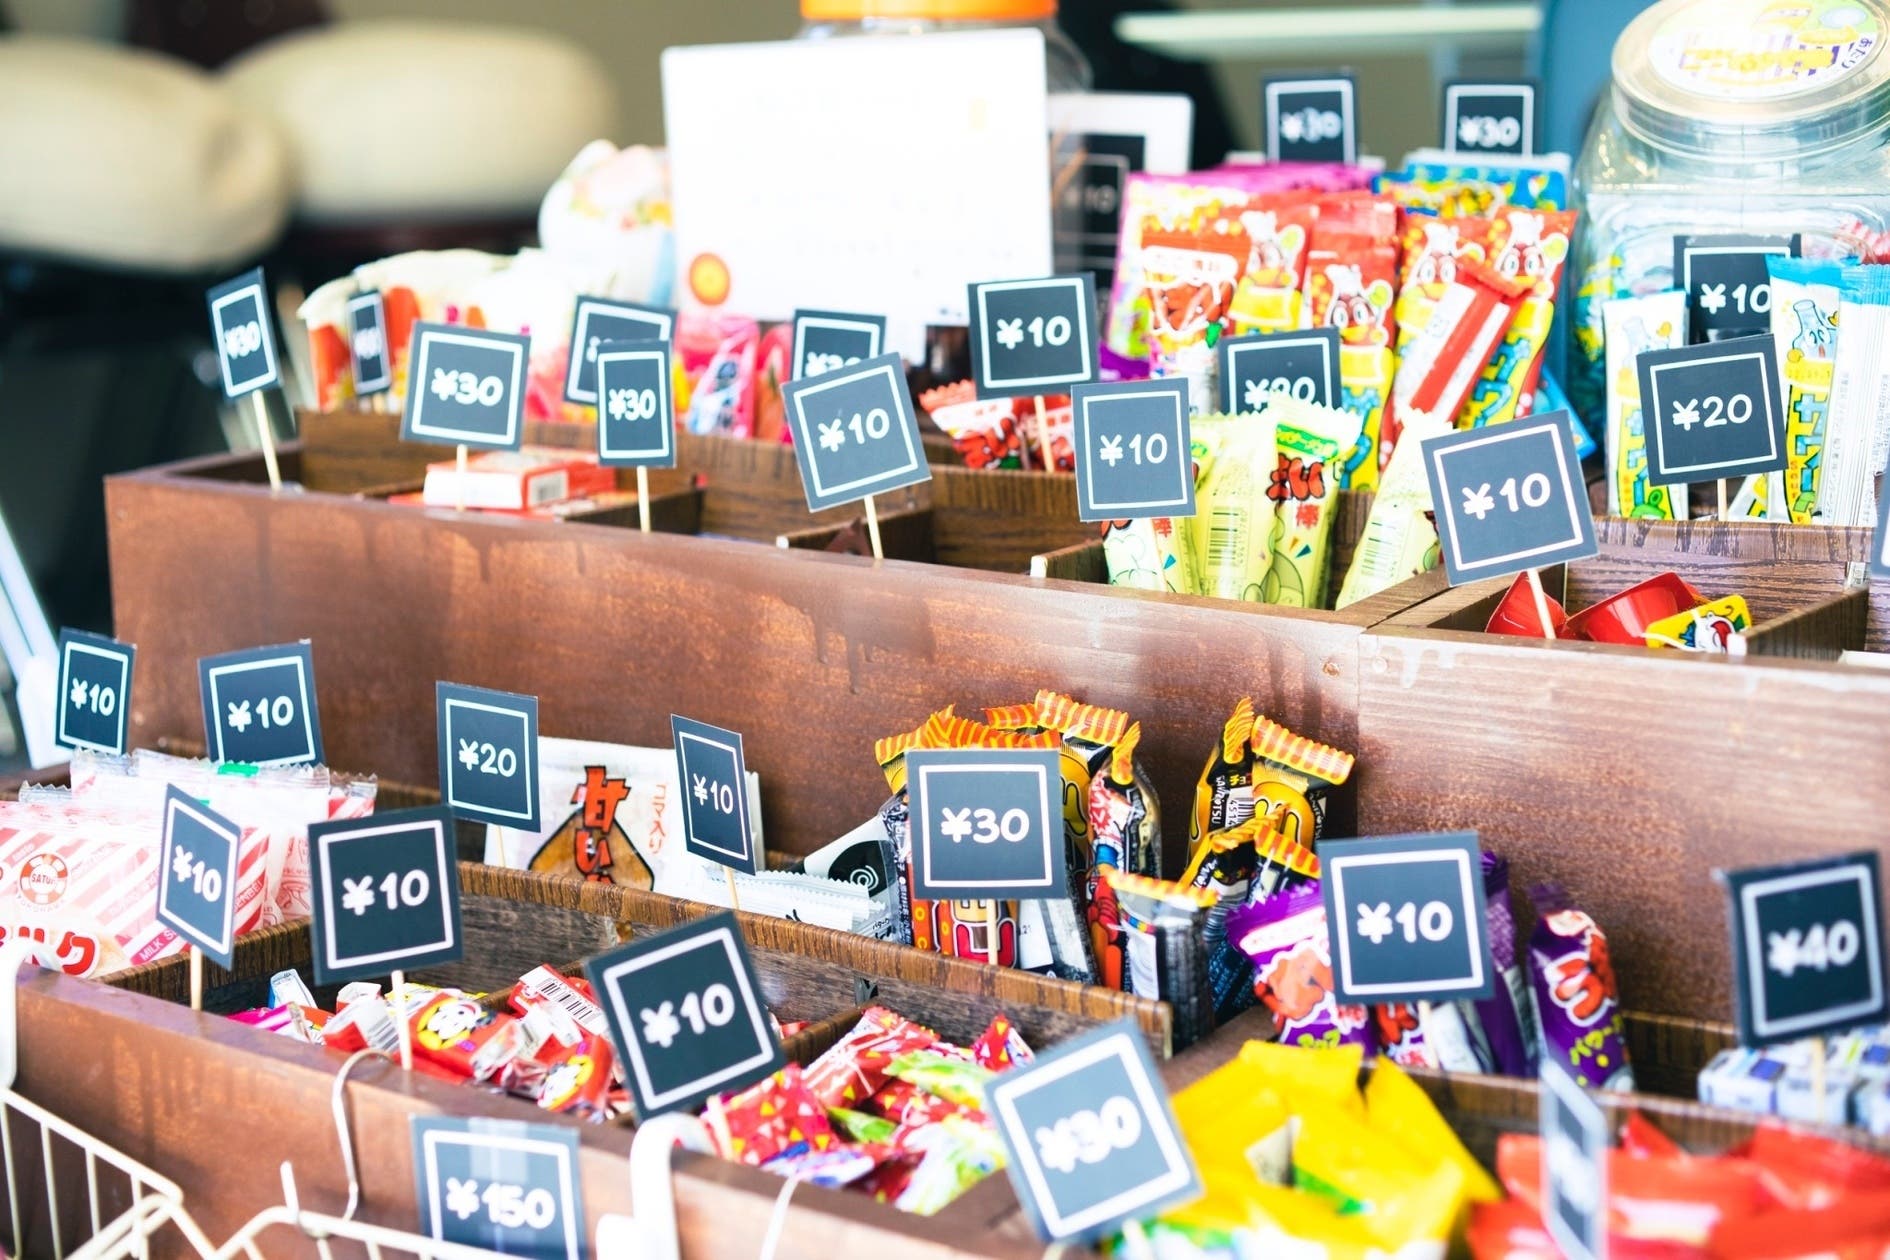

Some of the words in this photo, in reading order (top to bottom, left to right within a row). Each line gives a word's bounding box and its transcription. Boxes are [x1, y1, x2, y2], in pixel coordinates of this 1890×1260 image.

[1459, 117, 1520, 147] ¥30
[223, 320, 260, 359] ¥30
[997, 316, 1071, 349] ¥10
[431, 368, 503, 406] ¥30
[609, 389, 656, 420] ¥30
[818, 409, 889, 452] ¥10
[1673, 394, 1752, 430] ¥20
[1100, 434, 1167, 466] ¥10
[1462, 473, 1550, 519] ¥10
[71, 678, 115, 716] ¥10
[228, 696, 293, 732] ¥10
[459, 739, 516, 777] ¥20
[694, 774, 734, 814] ¥10
[570, 765, 632, 884] 甘い
[941, 808, 1029, 843] ¥30
[173, 845, 222, 901] ¥10
[236, 880, 263, 911] ENBEI
[343, 870, 429, 915] ¥10
[1357, 901, 1452, 943] ¥10
[139, 937, 165, 962] MILK
[1769, 922, 1858, 974] ¥40
[641, 984, 734, 1047] ¥10
[446, 1177, 556, 1229] ¥150
